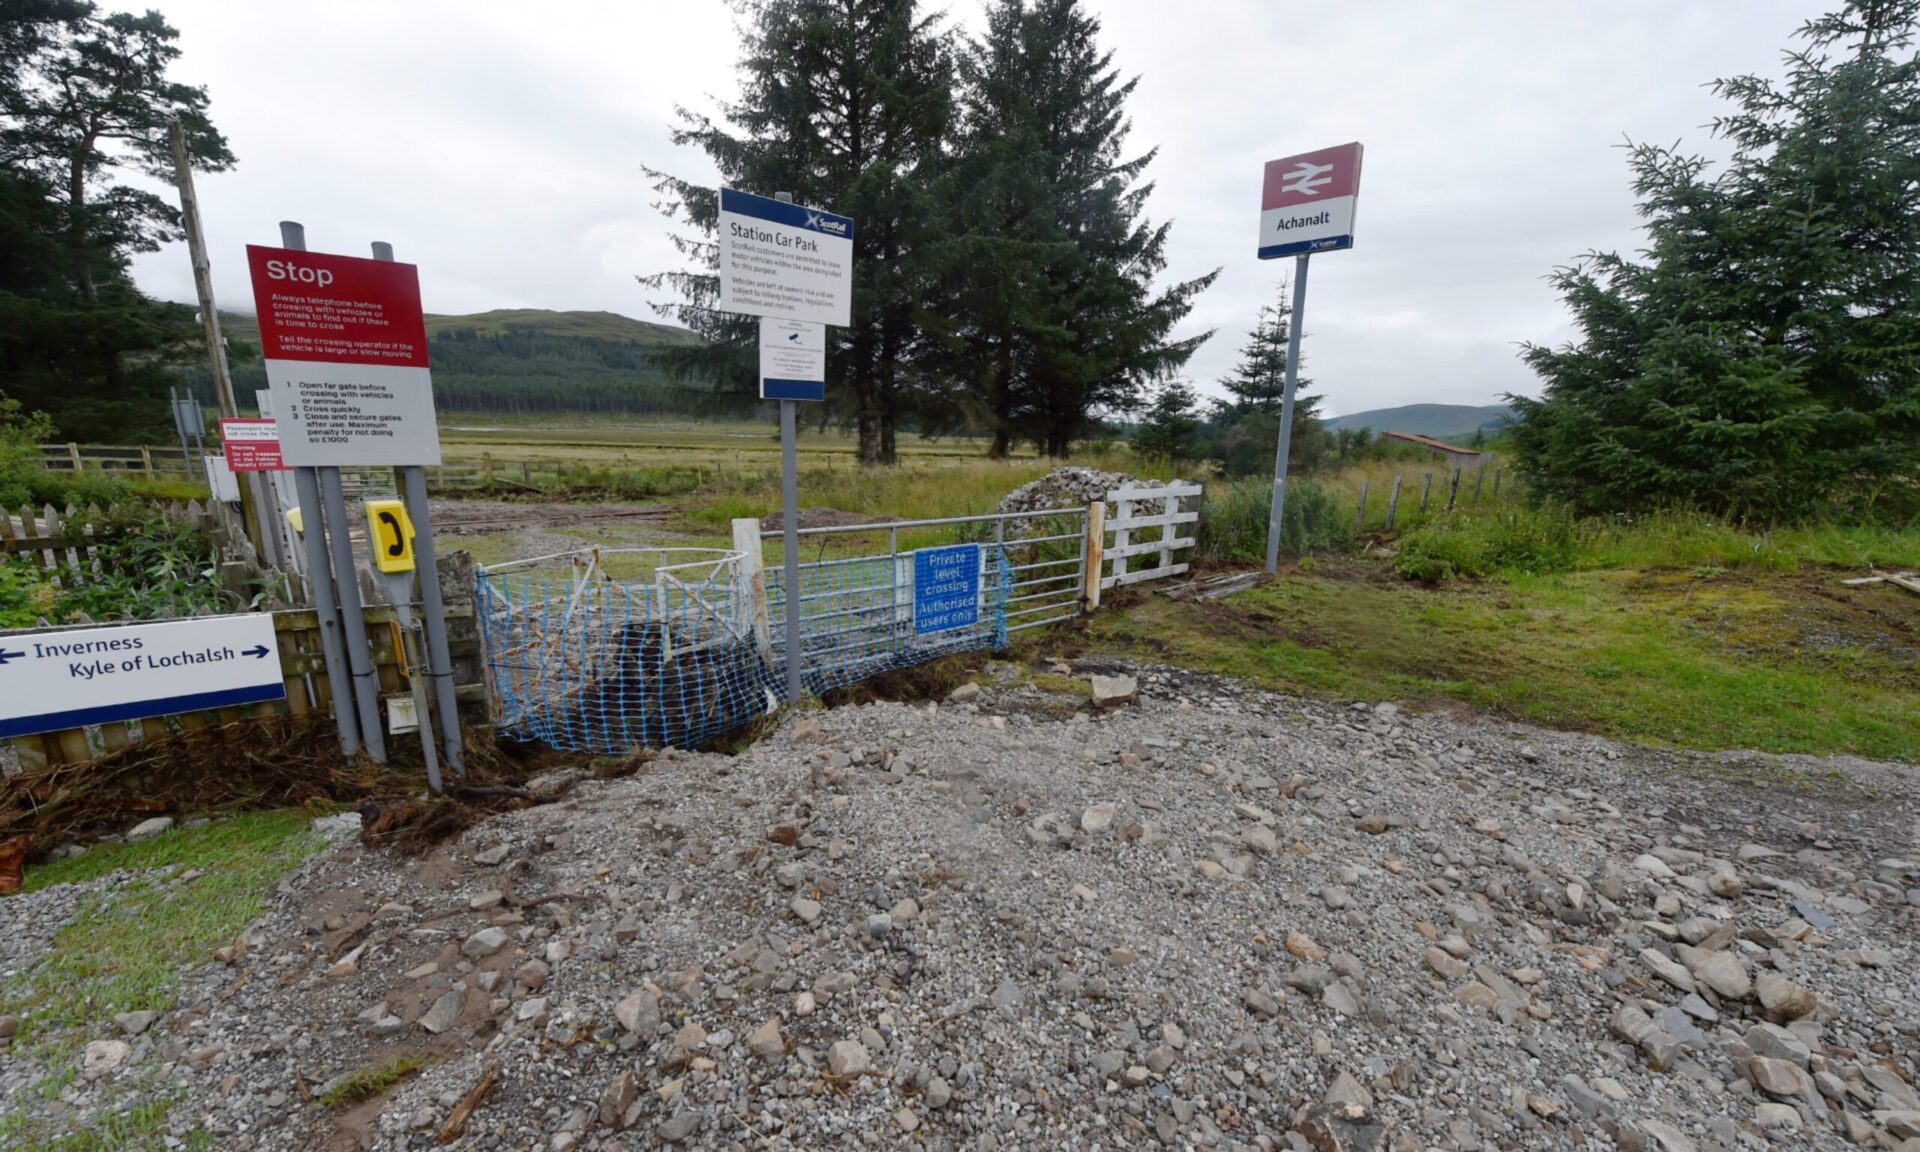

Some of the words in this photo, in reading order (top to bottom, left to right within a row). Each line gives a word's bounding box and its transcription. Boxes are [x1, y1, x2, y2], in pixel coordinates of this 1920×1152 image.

[820, 218, 847, 232] ScotRail
[1277, 211, 1330, 231] Achanalt
[731, 222, 773, 243] Station
[776, 232, 793, 248] Car
[796, 237, 818, 252] Park
[756, 246, 785, 258] customers
[742, 262, 753, 271] this
[774, 258, 791, 268] within
[267, 260, 333, 287] Stop
[731, 276, 755, 286] Vehicles
[766, 281, 776, 290] left
[272, 294, 305, 303] Always
[307, 296, 352, 306] telephone
[354, 301, 382, 310] before
[273, 303, 313, 312] crossing
[315, 305, 334, 313] with
[337, 307, 373, 317] vehicles
[274, 311, 310, 320] animals
[324, 314, 340, 322] find
[366, 318, 389, 326] there
[314, 338, 352, 348] crossing
[354, 341, 390, 349] operator
[280, 344, 314, 352] vehicle
[325, 346, 347, 355] large
[382, 350, 412, 359] moving
[930, 553, 965, 566] Private
[936, 567, 960, 579] level
[926, 581, 968, 595] crossing
[920, 595, 975, 613] Authorised
[921, 615, 949, 627] users
[952, 611, 972, 622] only
[33, 638, 143, 658] Inverness
[70, 660, 115, 680] Kyle
[122, 656, 143, 672] of
[148, 647, 234, 668] Lochalsh
